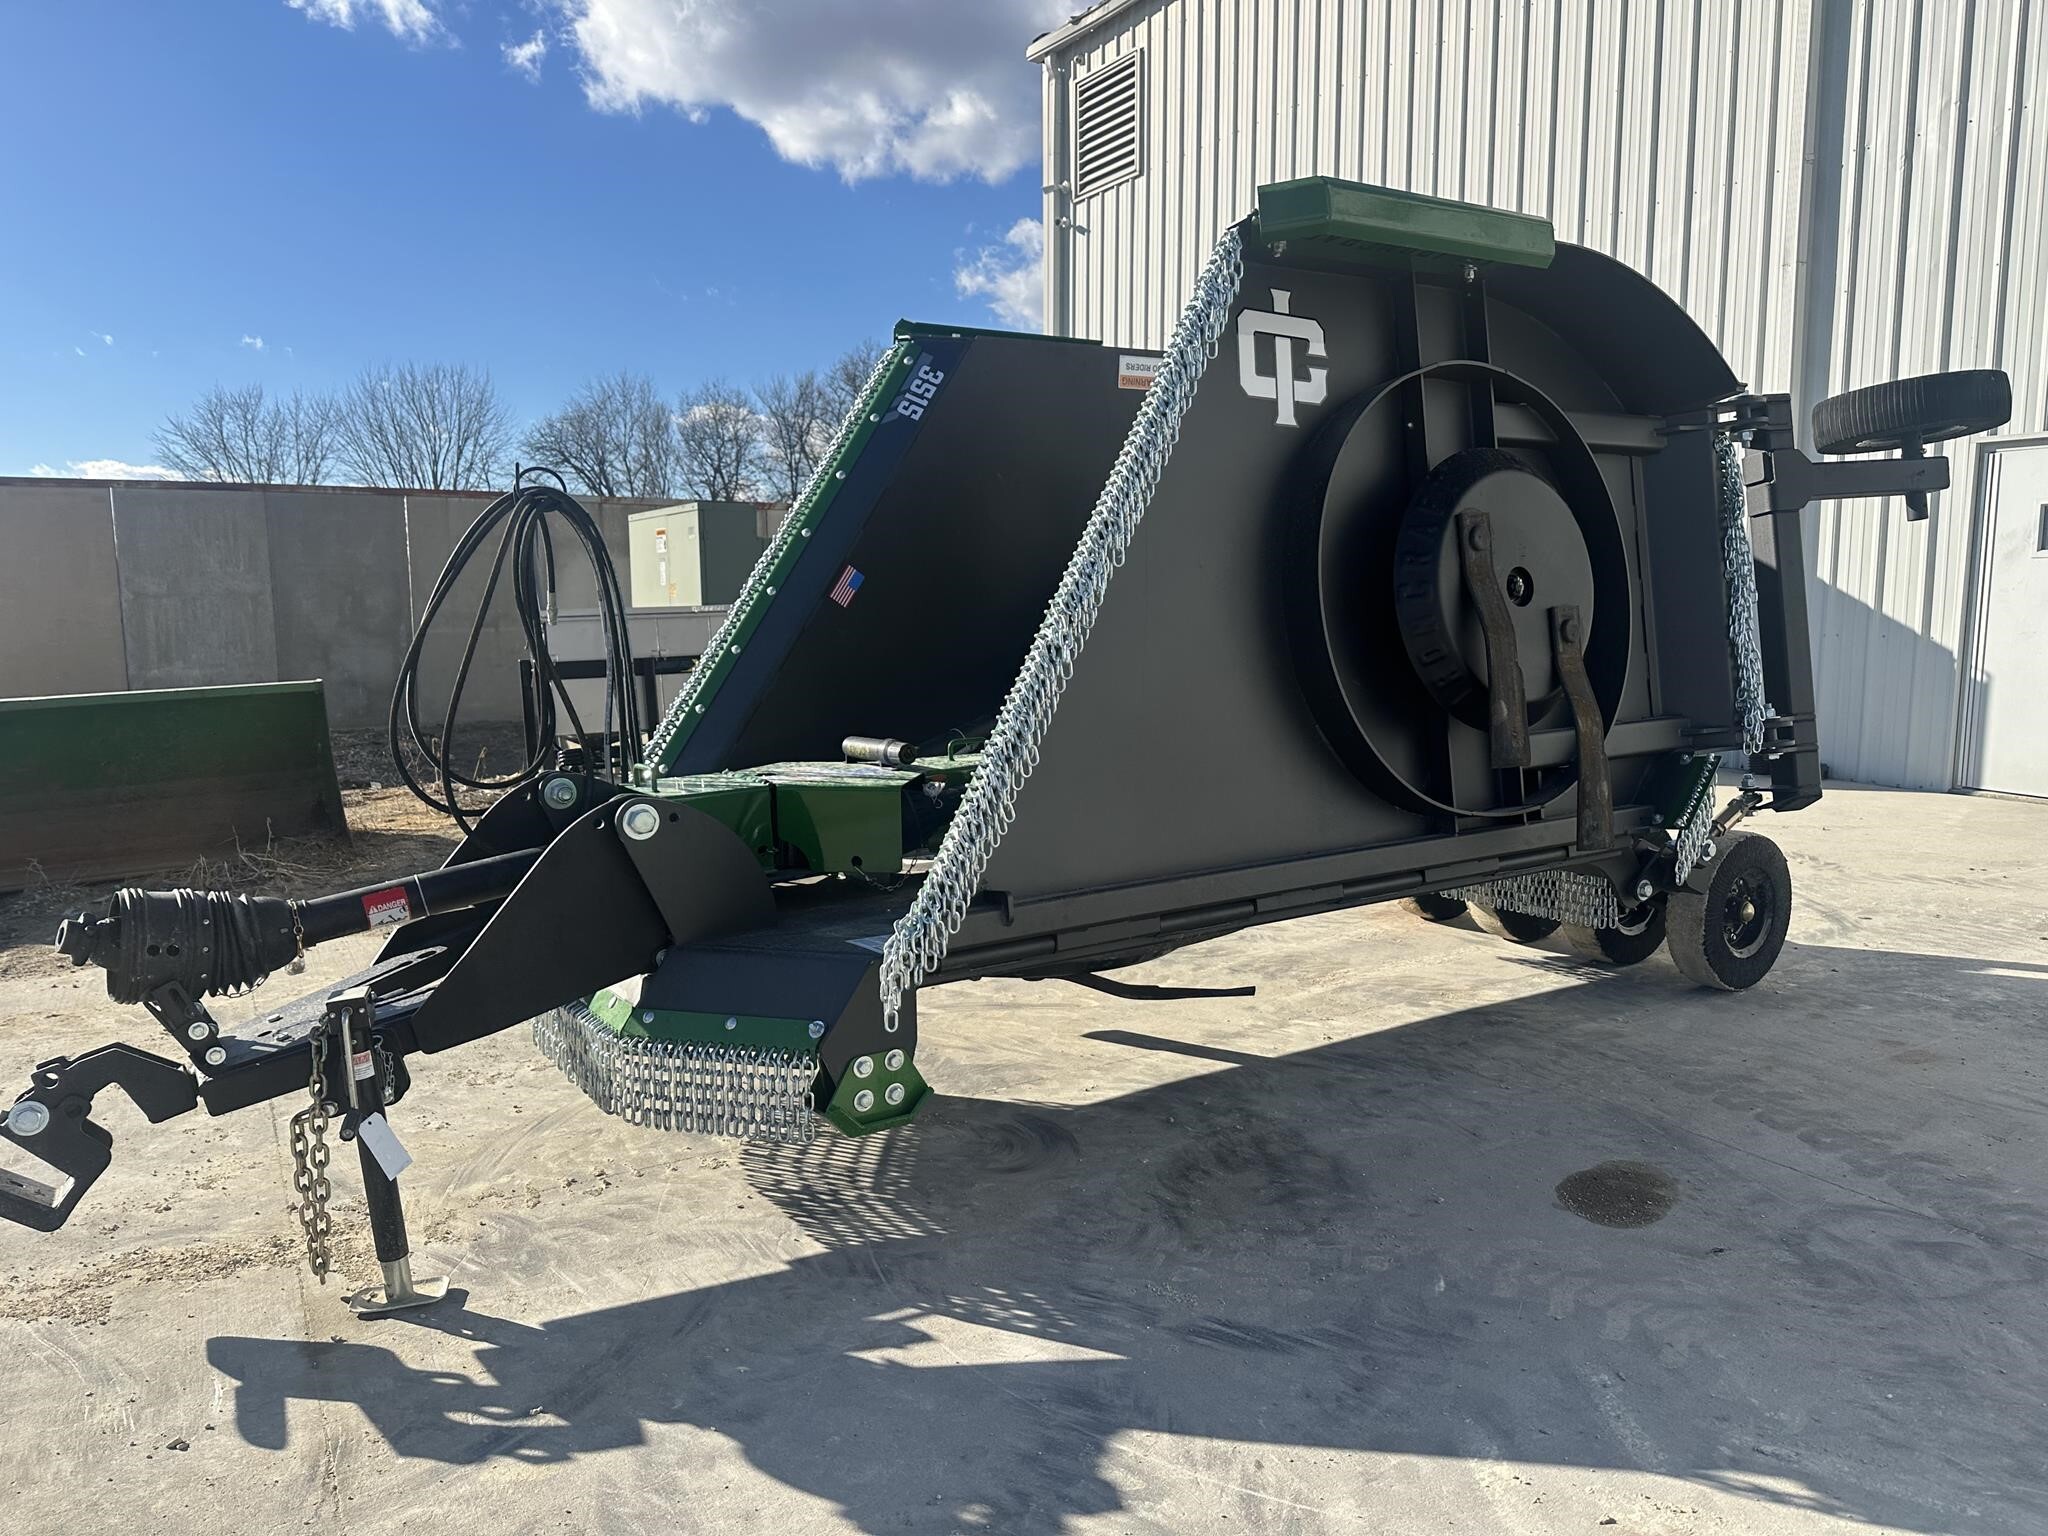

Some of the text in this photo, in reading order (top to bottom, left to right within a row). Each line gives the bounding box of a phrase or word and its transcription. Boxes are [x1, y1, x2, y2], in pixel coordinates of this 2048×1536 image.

[1125, 362, 1151, 372] RIDERS
[1121, 376, 1152, 387] ARNING
[896, 365, 945, 421] 3515
[377, 898, 406, 912] DANGER
